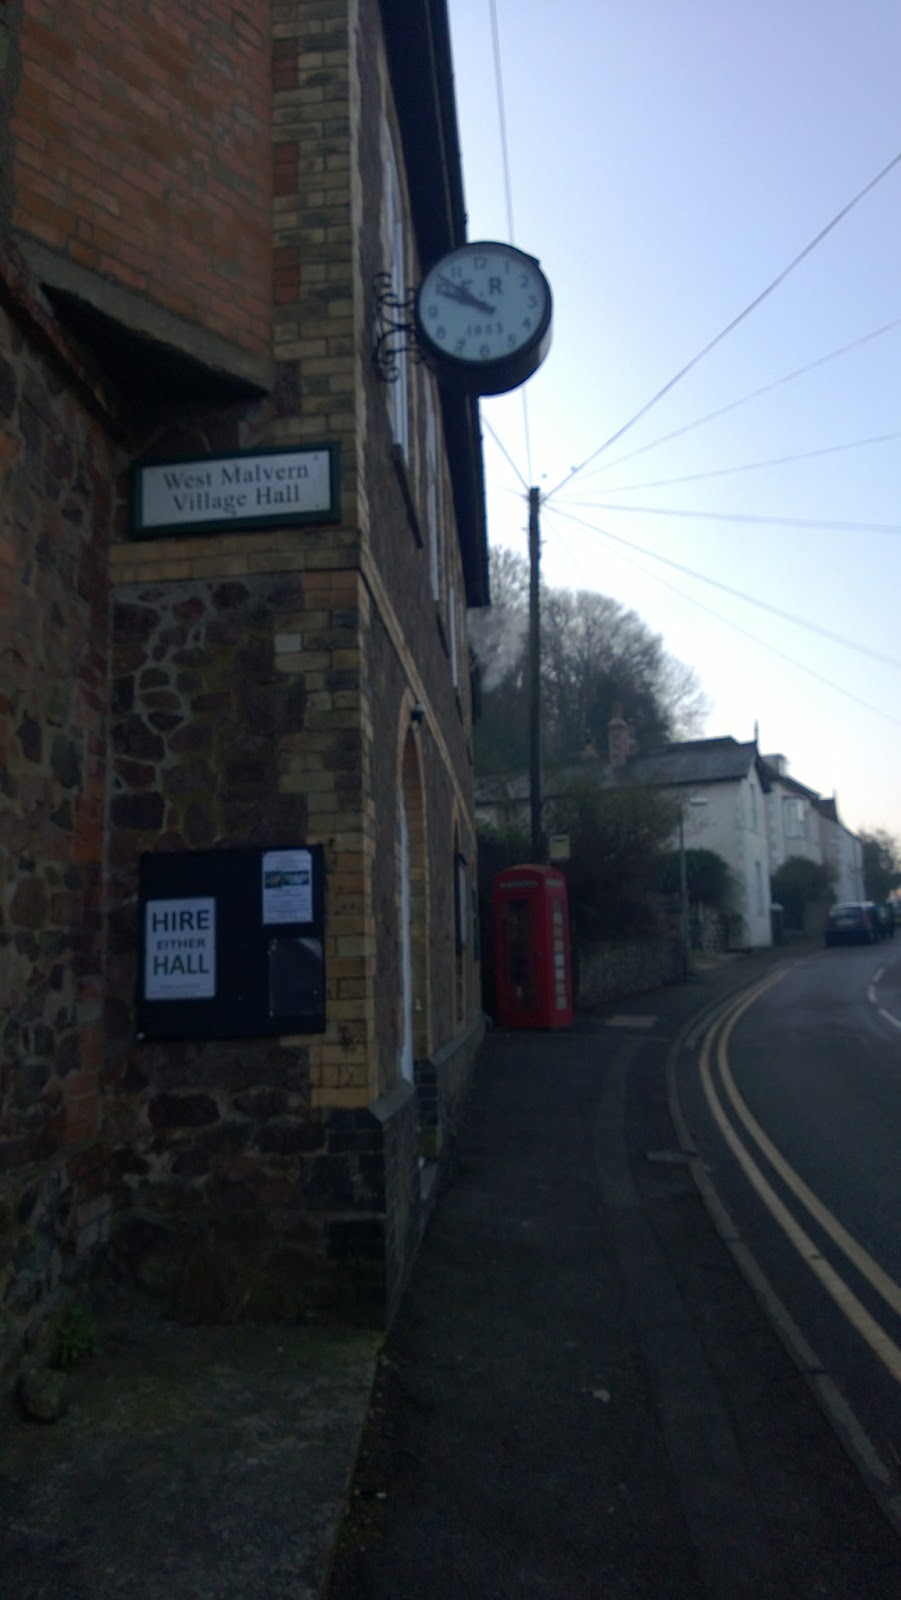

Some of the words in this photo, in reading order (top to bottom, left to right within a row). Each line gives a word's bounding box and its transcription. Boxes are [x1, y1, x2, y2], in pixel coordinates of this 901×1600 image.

[474, 257, 487, 269] 12
[504, 261, 510, 273] 1
[451, 266, 462, 278] 11
[489, 276, 503, 295] R
[520, 275, 529, 288] 2
[528, 296, 537, 309] 3
[522, 318, 531, 330] 4
[163, 470, 213, 490] West
[221, 463, 309, 486] Malvern
[172, 491, 247, 516] Village
[256, 484, 300, 506] Hall
[152, 910, 209, 933] HIRE
[156, 939, 205, 951] EITHER
[153, 954, 209, 975] HALL
